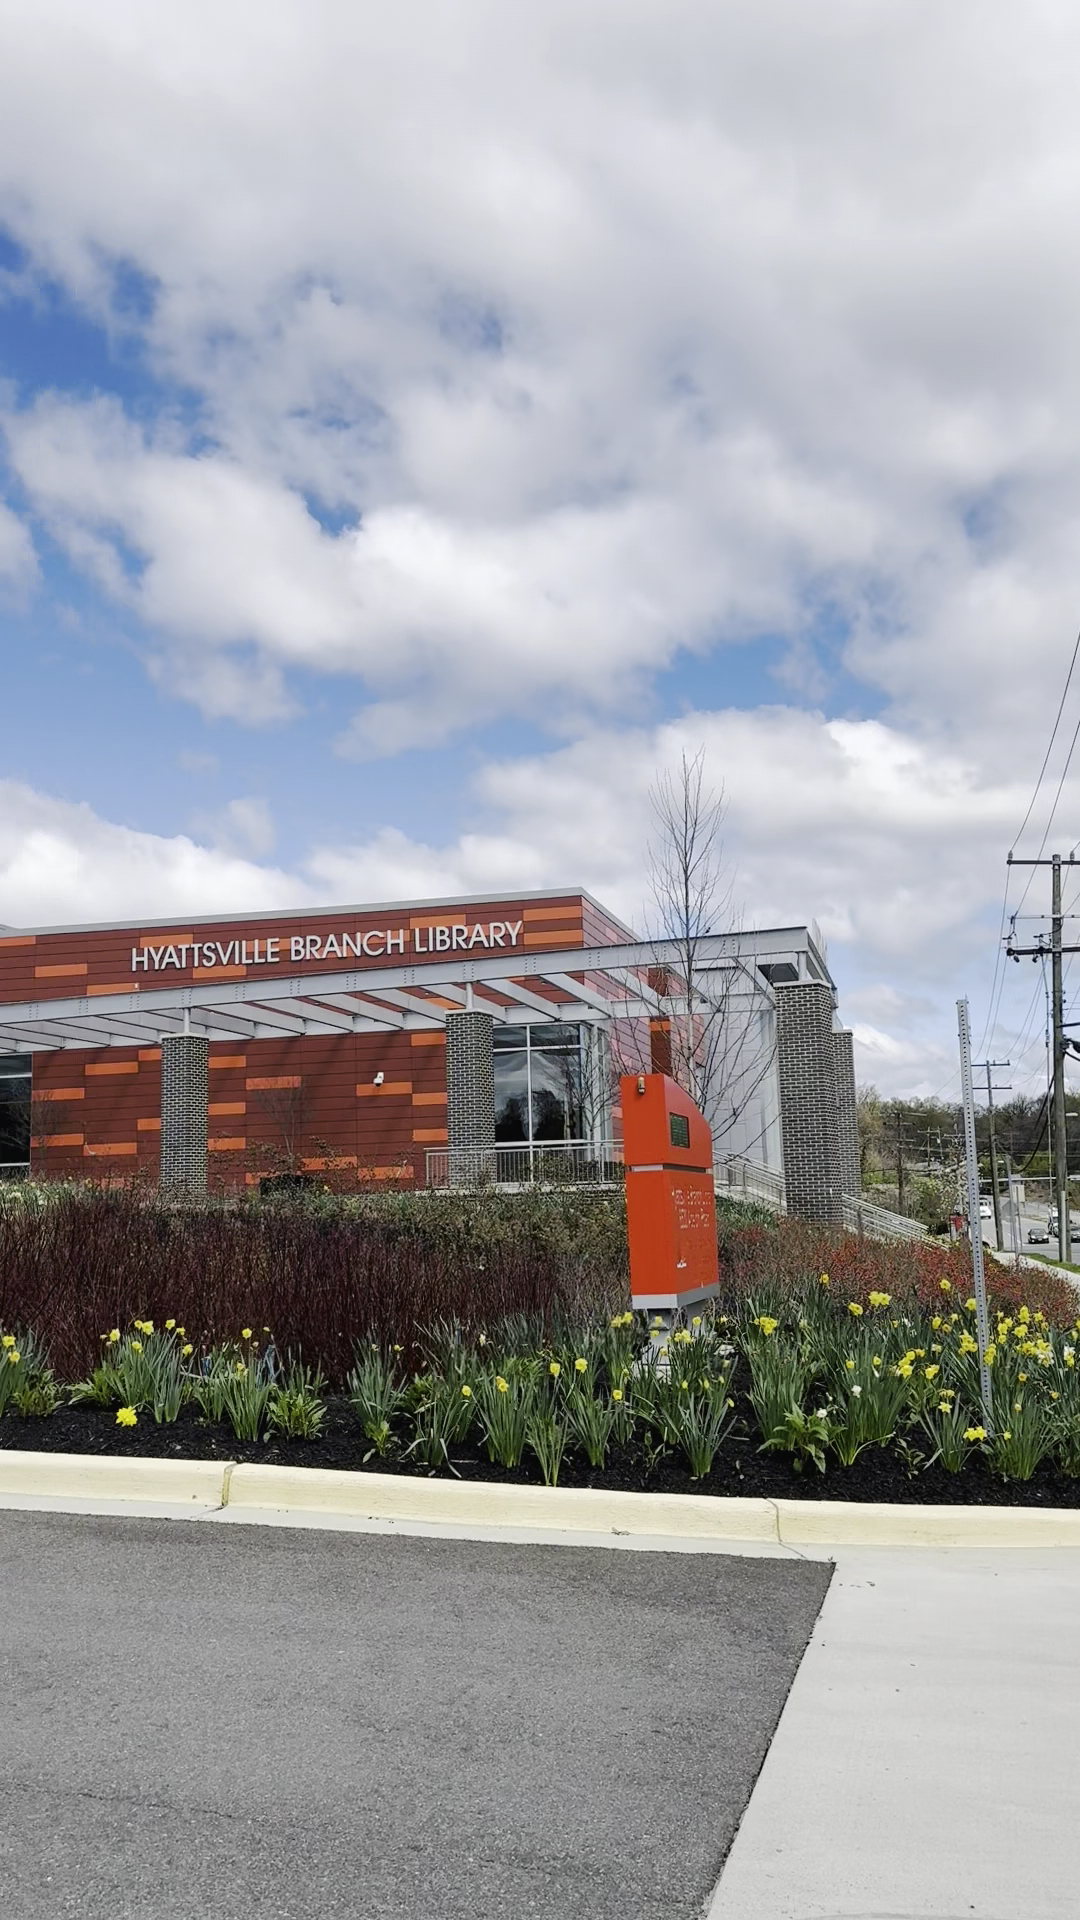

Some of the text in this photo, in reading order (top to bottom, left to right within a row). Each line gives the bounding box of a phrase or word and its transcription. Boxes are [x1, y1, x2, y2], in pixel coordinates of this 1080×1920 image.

[131, 920, 523, 972] HYATTSVILLE BRANCH LIBRARY
